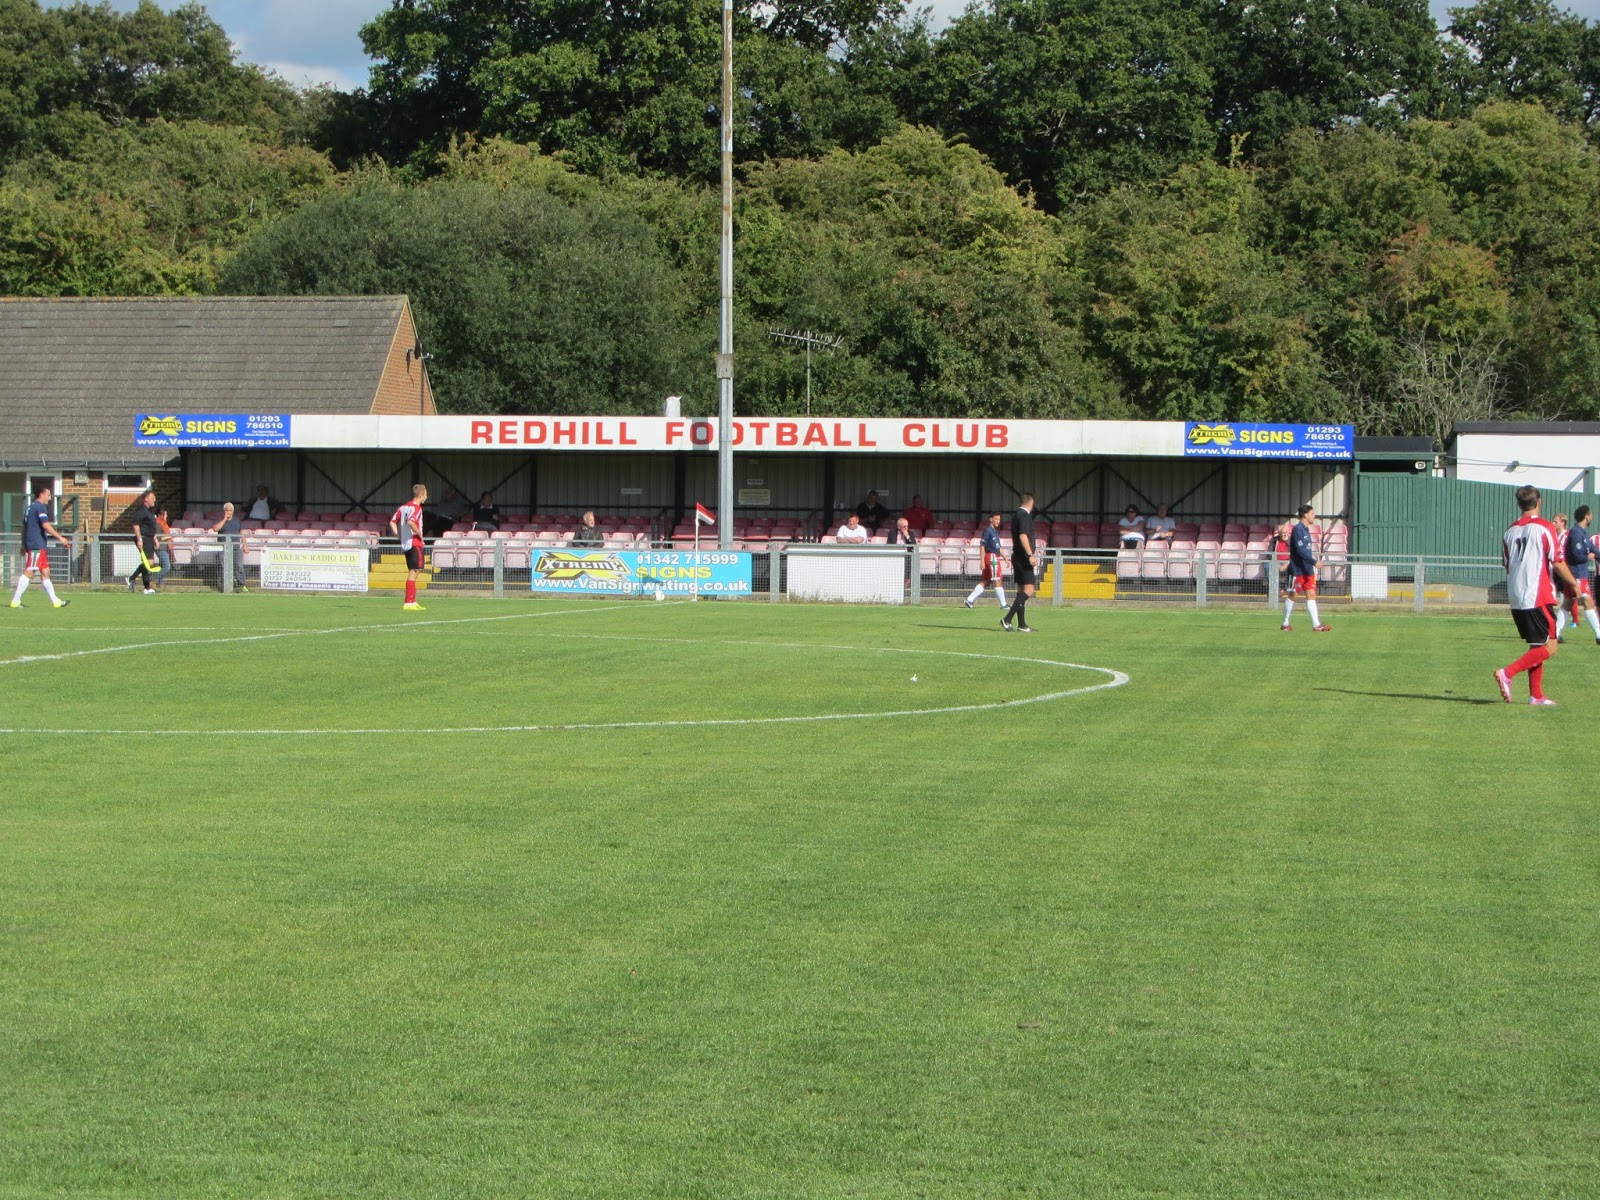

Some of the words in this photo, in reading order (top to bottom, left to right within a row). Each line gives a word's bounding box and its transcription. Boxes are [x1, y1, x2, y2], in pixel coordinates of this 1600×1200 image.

[186, 420, 237, 433] SIGNS
[1307, 426, 1341, 434] 01293
[470, 420, 637, 445] REDHILL
[902, 423, 1009, 448] CLUB
[1239, 430, 1294, 443] SIGNS
[1304, 433, 1345, 441] 786510
[137, 437, 289, 447] www.VanSignwriting.co.uk
[1186, 447, 1351, 459] www.VanSignwriting.co.uk
[273, 553, 309, 561] BAKER'S
[310, 554, 337, 562] RADIO
[637, 553, 680, 565] 01342
[684, 553, 739, 566] 715999
[636, 565, 712, 579] SIGNS
[533, 577, 749, 594] www.VanSignwriting.co.uk
